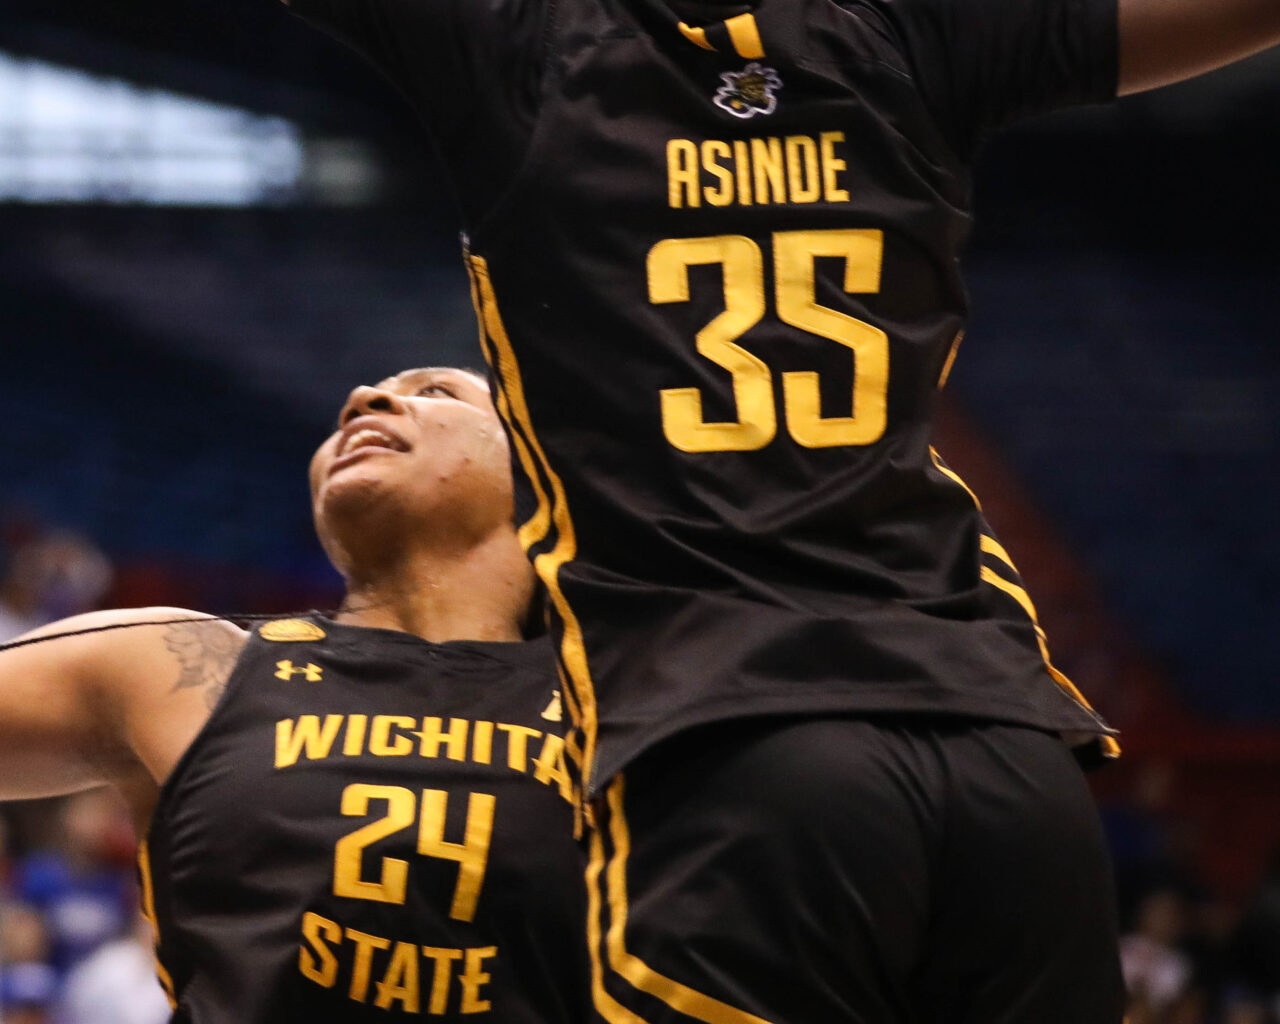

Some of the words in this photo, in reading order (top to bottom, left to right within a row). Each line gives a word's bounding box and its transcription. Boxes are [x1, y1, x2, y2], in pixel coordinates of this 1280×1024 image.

[666, 131, 850, 208] ASINDE
[646, 229, 890, 453] 35
[273, 714, 579, 806] WICHITA
[332, 783, 497, 922] 24
[298, 911, 498, 1015] STATE
